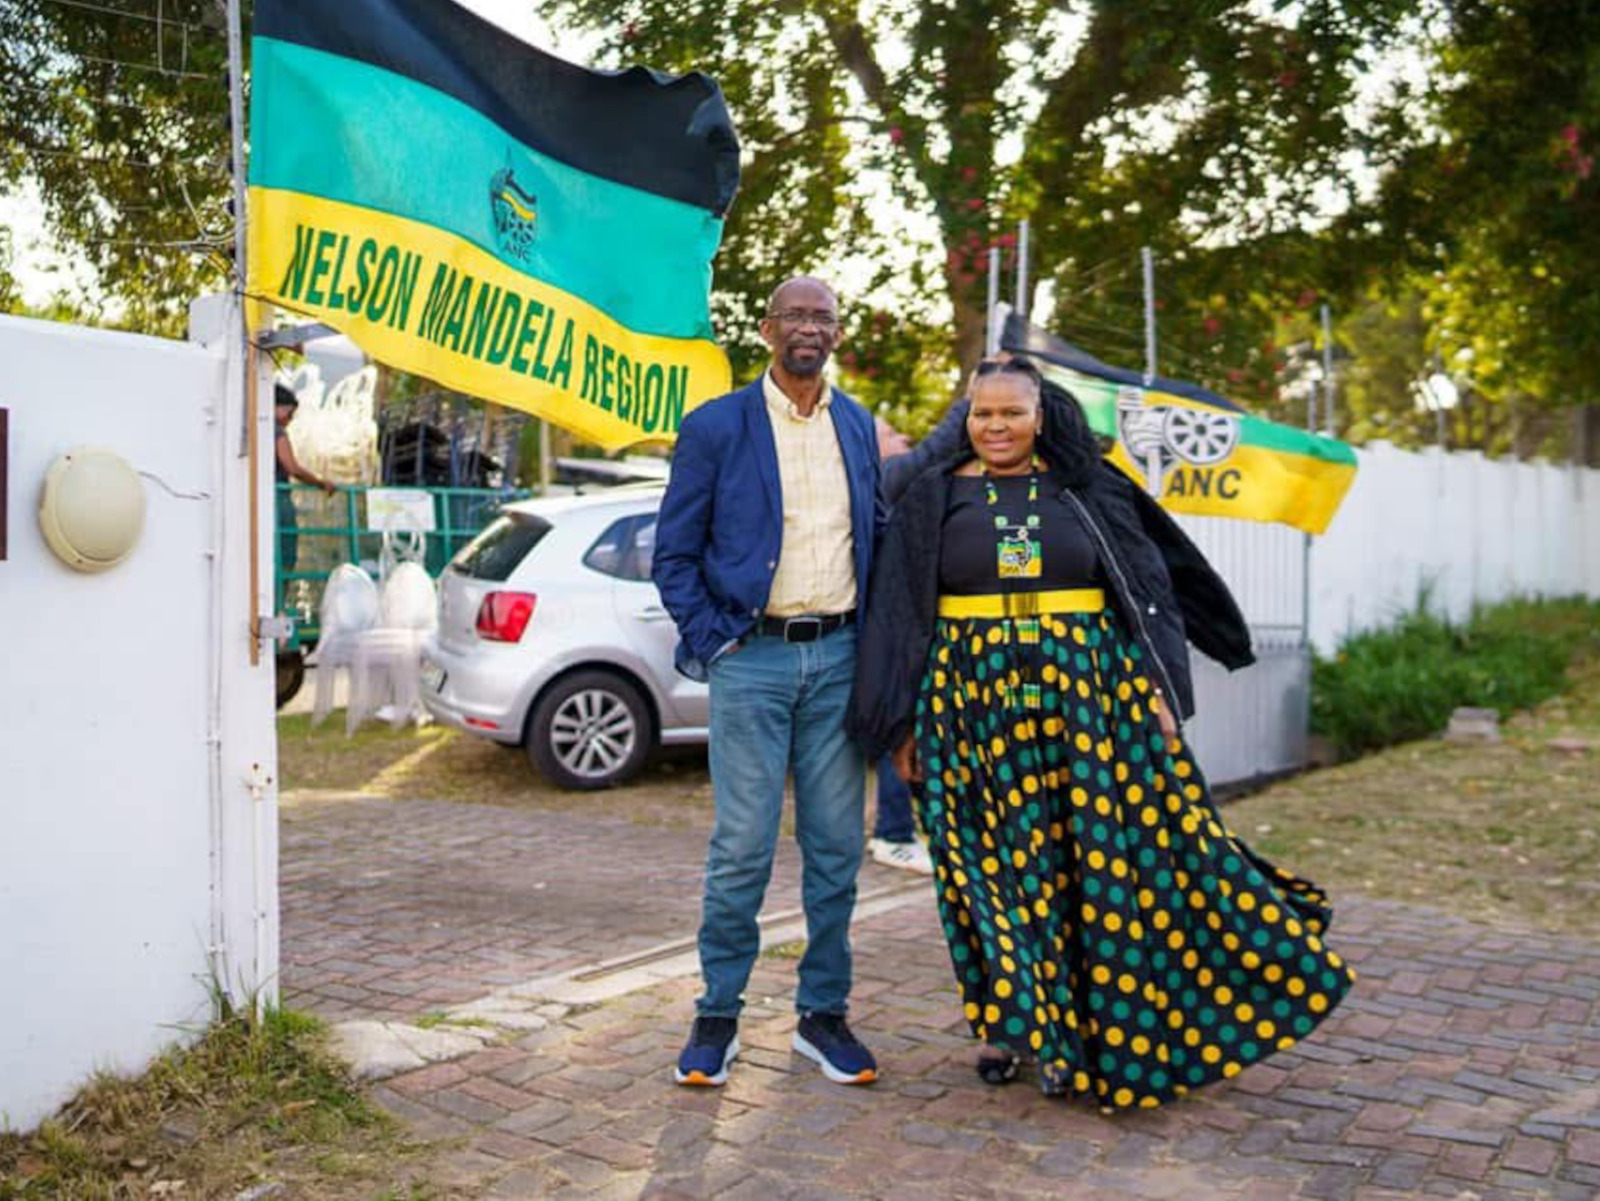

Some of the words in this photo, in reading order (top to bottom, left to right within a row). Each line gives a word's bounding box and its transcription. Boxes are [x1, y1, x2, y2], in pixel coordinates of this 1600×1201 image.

[280, 224, 423, 331] NELSON
[417, 263, 575, 390] MANDELA
[581, 333, 688, 433] REGION
[1166, 469, 1242, 499] ANC
